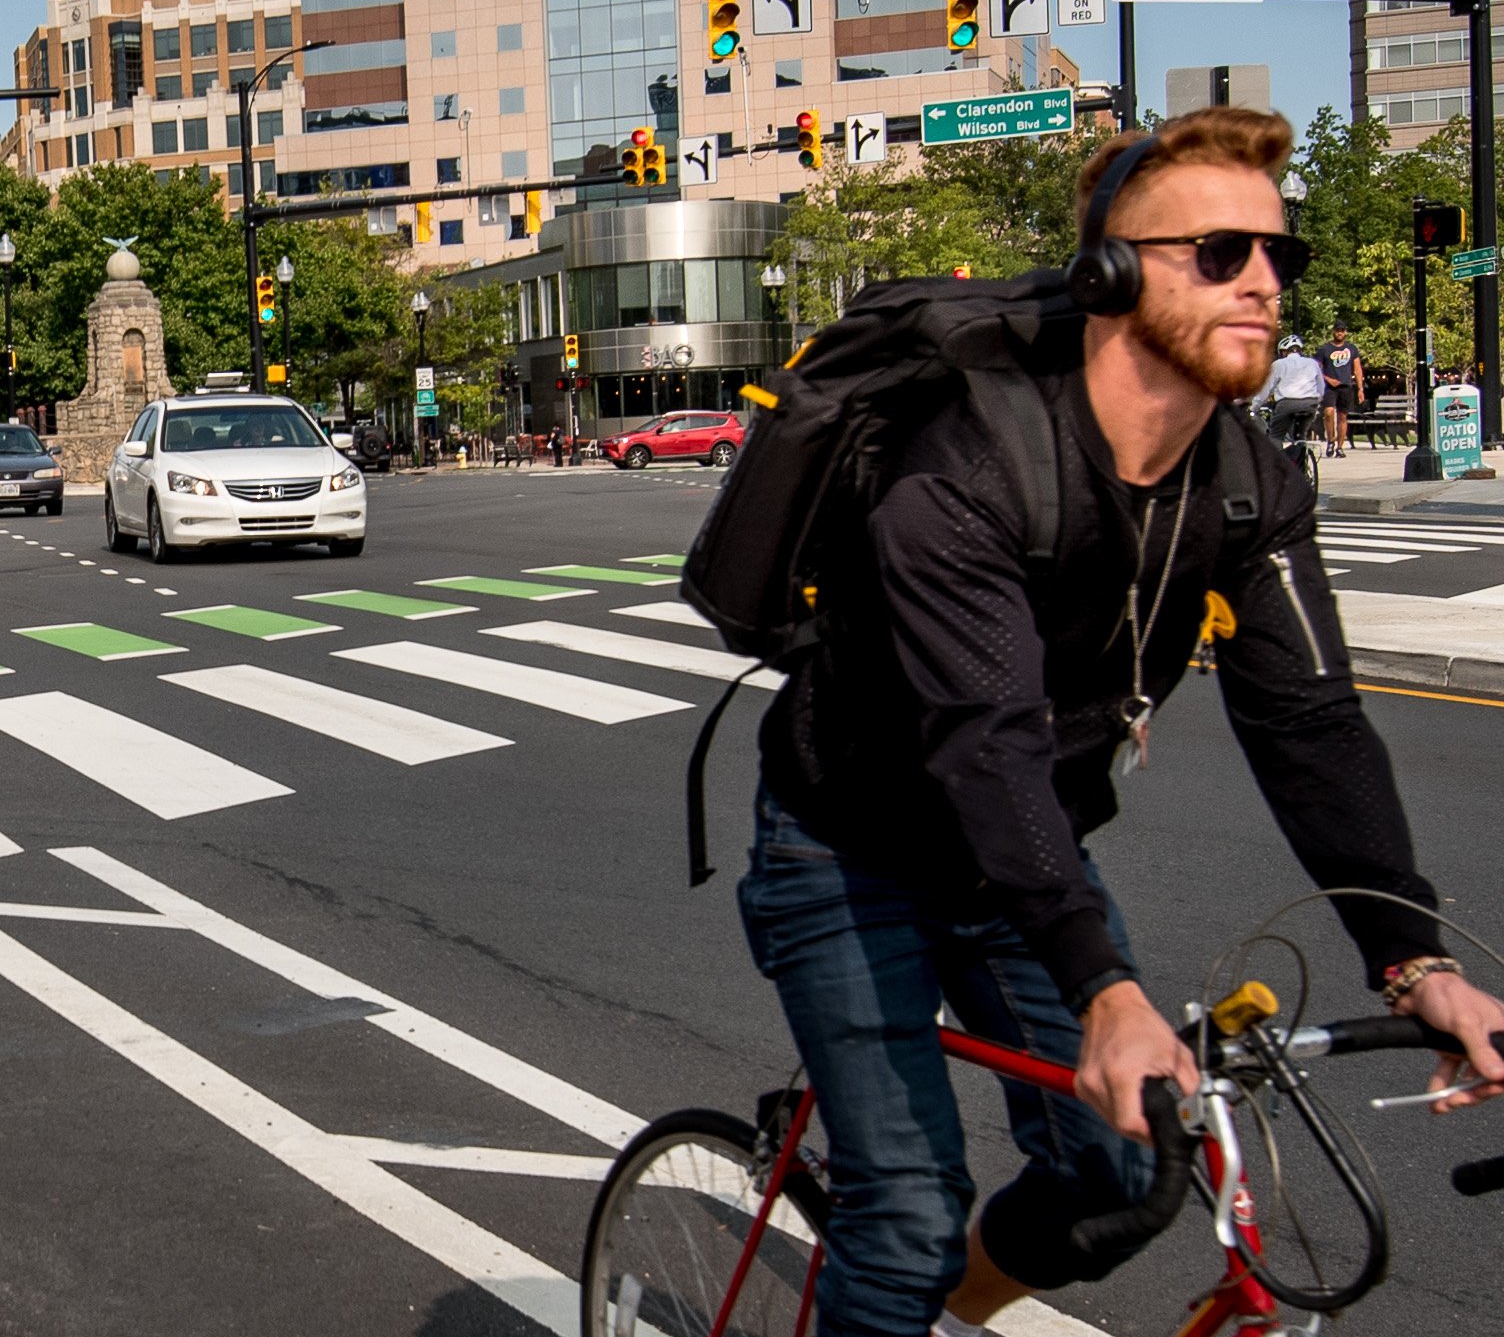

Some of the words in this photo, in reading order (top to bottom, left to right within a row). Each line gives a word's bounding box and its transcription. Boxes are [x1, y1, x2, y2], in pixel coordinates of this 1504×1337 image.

[1074, 0, 1089, 8] ON
[1071, 11, 1092, 21] RED
[956, 99, 1034, 118] Clarendon
[1043, 97, 1068, 110] Blvd
[957, 121, 1007, 137] Wilson
[1016, 119, 1040, 131] Blvd
[1439, 422, 1477, 438] PATIO
[1441, 436, 1478, 452] OPEN
